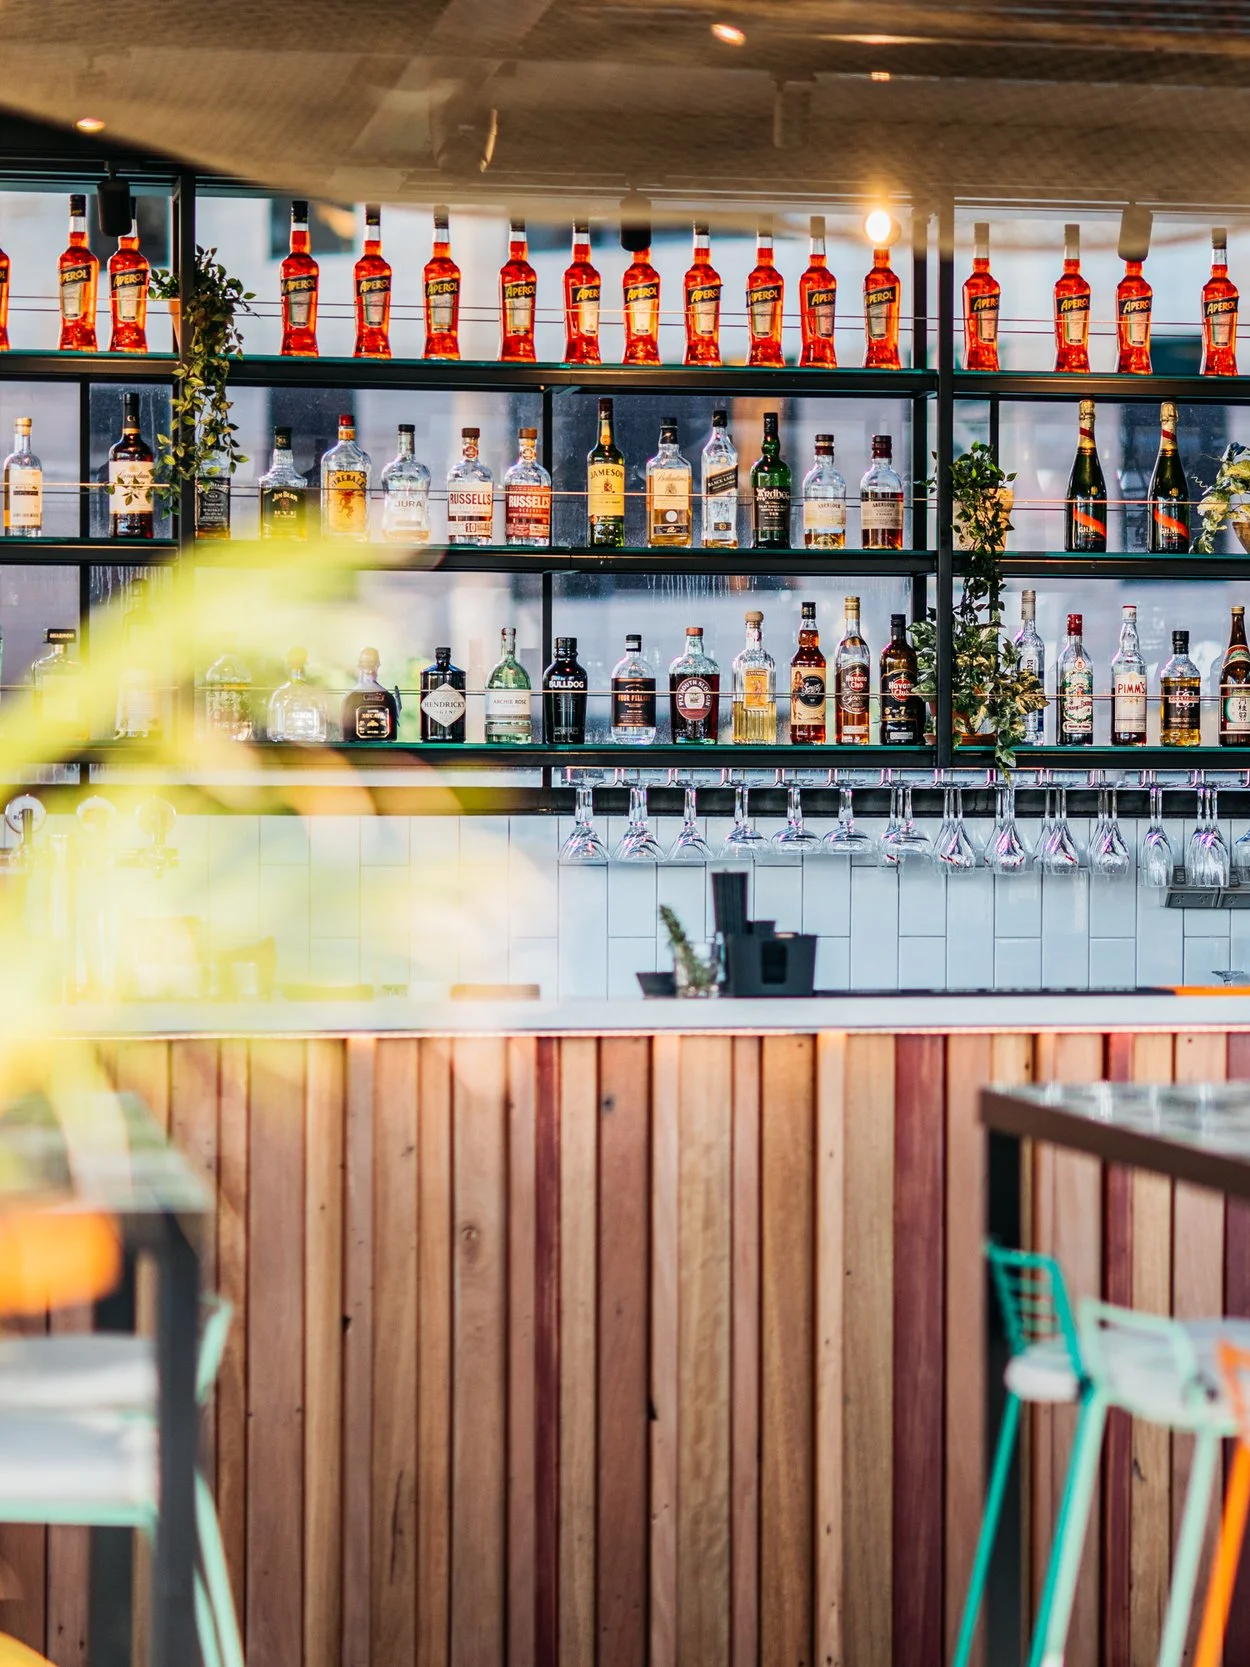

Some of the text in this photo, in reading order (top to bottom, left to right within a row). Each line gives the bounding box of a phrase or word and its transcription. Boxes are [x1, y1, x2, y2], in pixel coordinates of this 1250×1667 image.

[113, 273, 144, 288] APEROL
[285, 279, 315, 292] APEROL
[360, 280, 389, 293] APEROL
[427, 281, 458, 294] APEROL
[506, 285, 536, 297] APEROL
[627, 286, 657, 301] APEROL
[577, 288, 600, 301] APER
[749, 289, 779, 303] APEROL
[812, 292, 836, 305] APERO
[974, 298, 999, 310] APERO
[331, 474, 366, 489] FIREBALL
[708, 477, 723, 487] BLACK
[450, 493, 491, 505] RUSSELL'S
[756, 487, 790, 501] Ardbeg
[395, 500, 423, 508] JURA
[508, 495, 550, 508] RUSSELL'S
[467, 523, 476, 532] 10
[549, 680, 585, 688] BULLDOG
[1118, 681, 1146, 694] PIMM'S
[631, 694, 651, 702] PILLA
